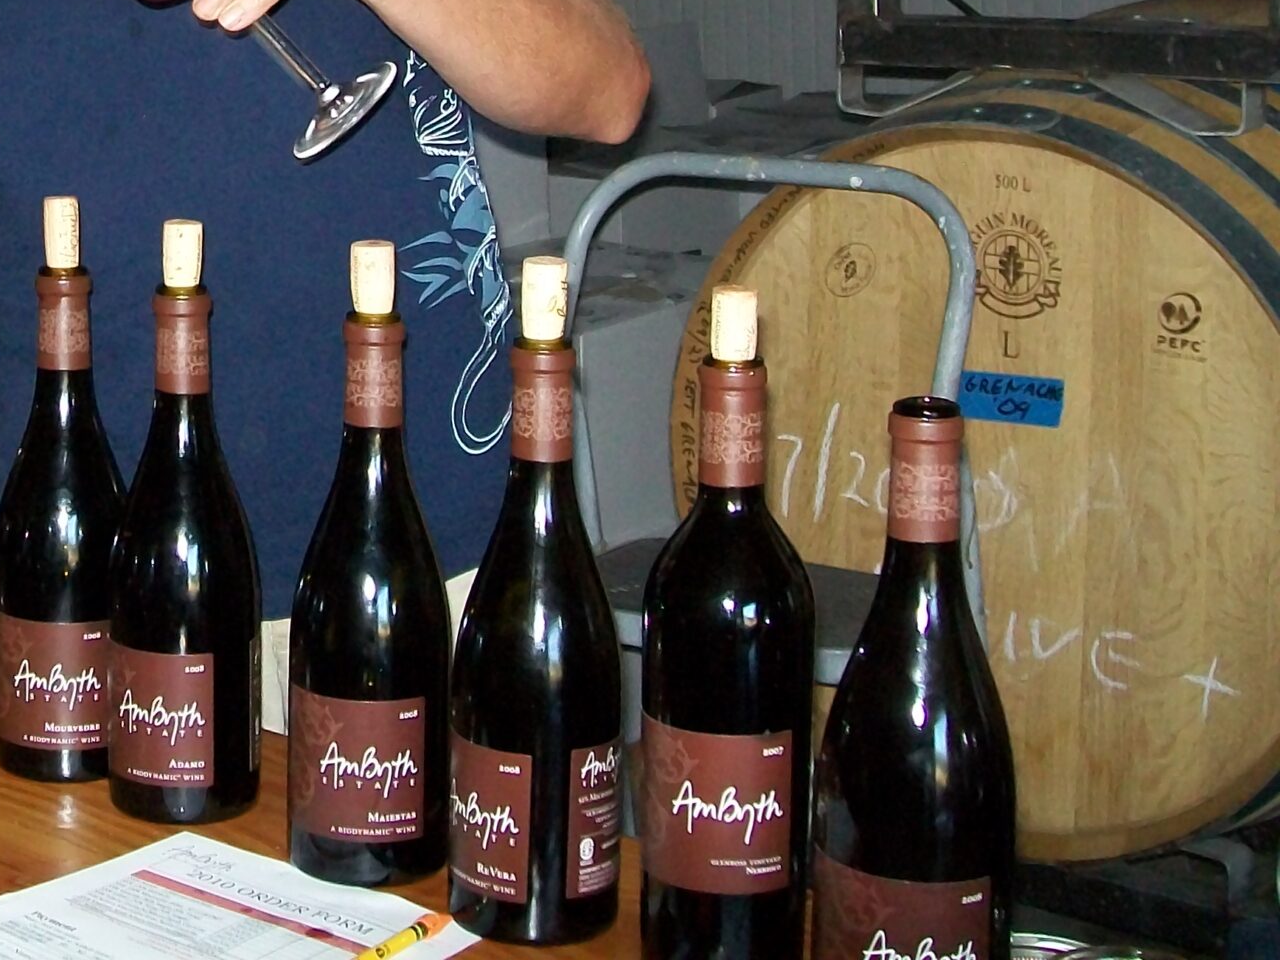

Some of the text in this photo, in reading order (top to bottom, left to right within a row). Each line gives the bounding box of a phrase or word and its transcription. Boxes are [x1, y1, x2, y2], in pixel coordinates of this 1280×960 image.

[995, 174, 1031, 192] 500 L
[1010, 212, 1063, 280] MOREAU
[1003, 611, 1141, 690] IVE
[14, 659, 101, 711] AmByth
[81, 736, 100, 744] WINE
[120, 689, 205, 746] AmByth
[169, 758, 205, 769] ADAMO
[320, 741, 418, 799] AmByth
[499, 765, 521, 775] 2008
[395, 825, 417, 834] WINE
[672, 780, 784, 845] AmByth
[186, 867, 375, 936] 2010 ORDER FORM
[493, 885, 517, 895] WINE
